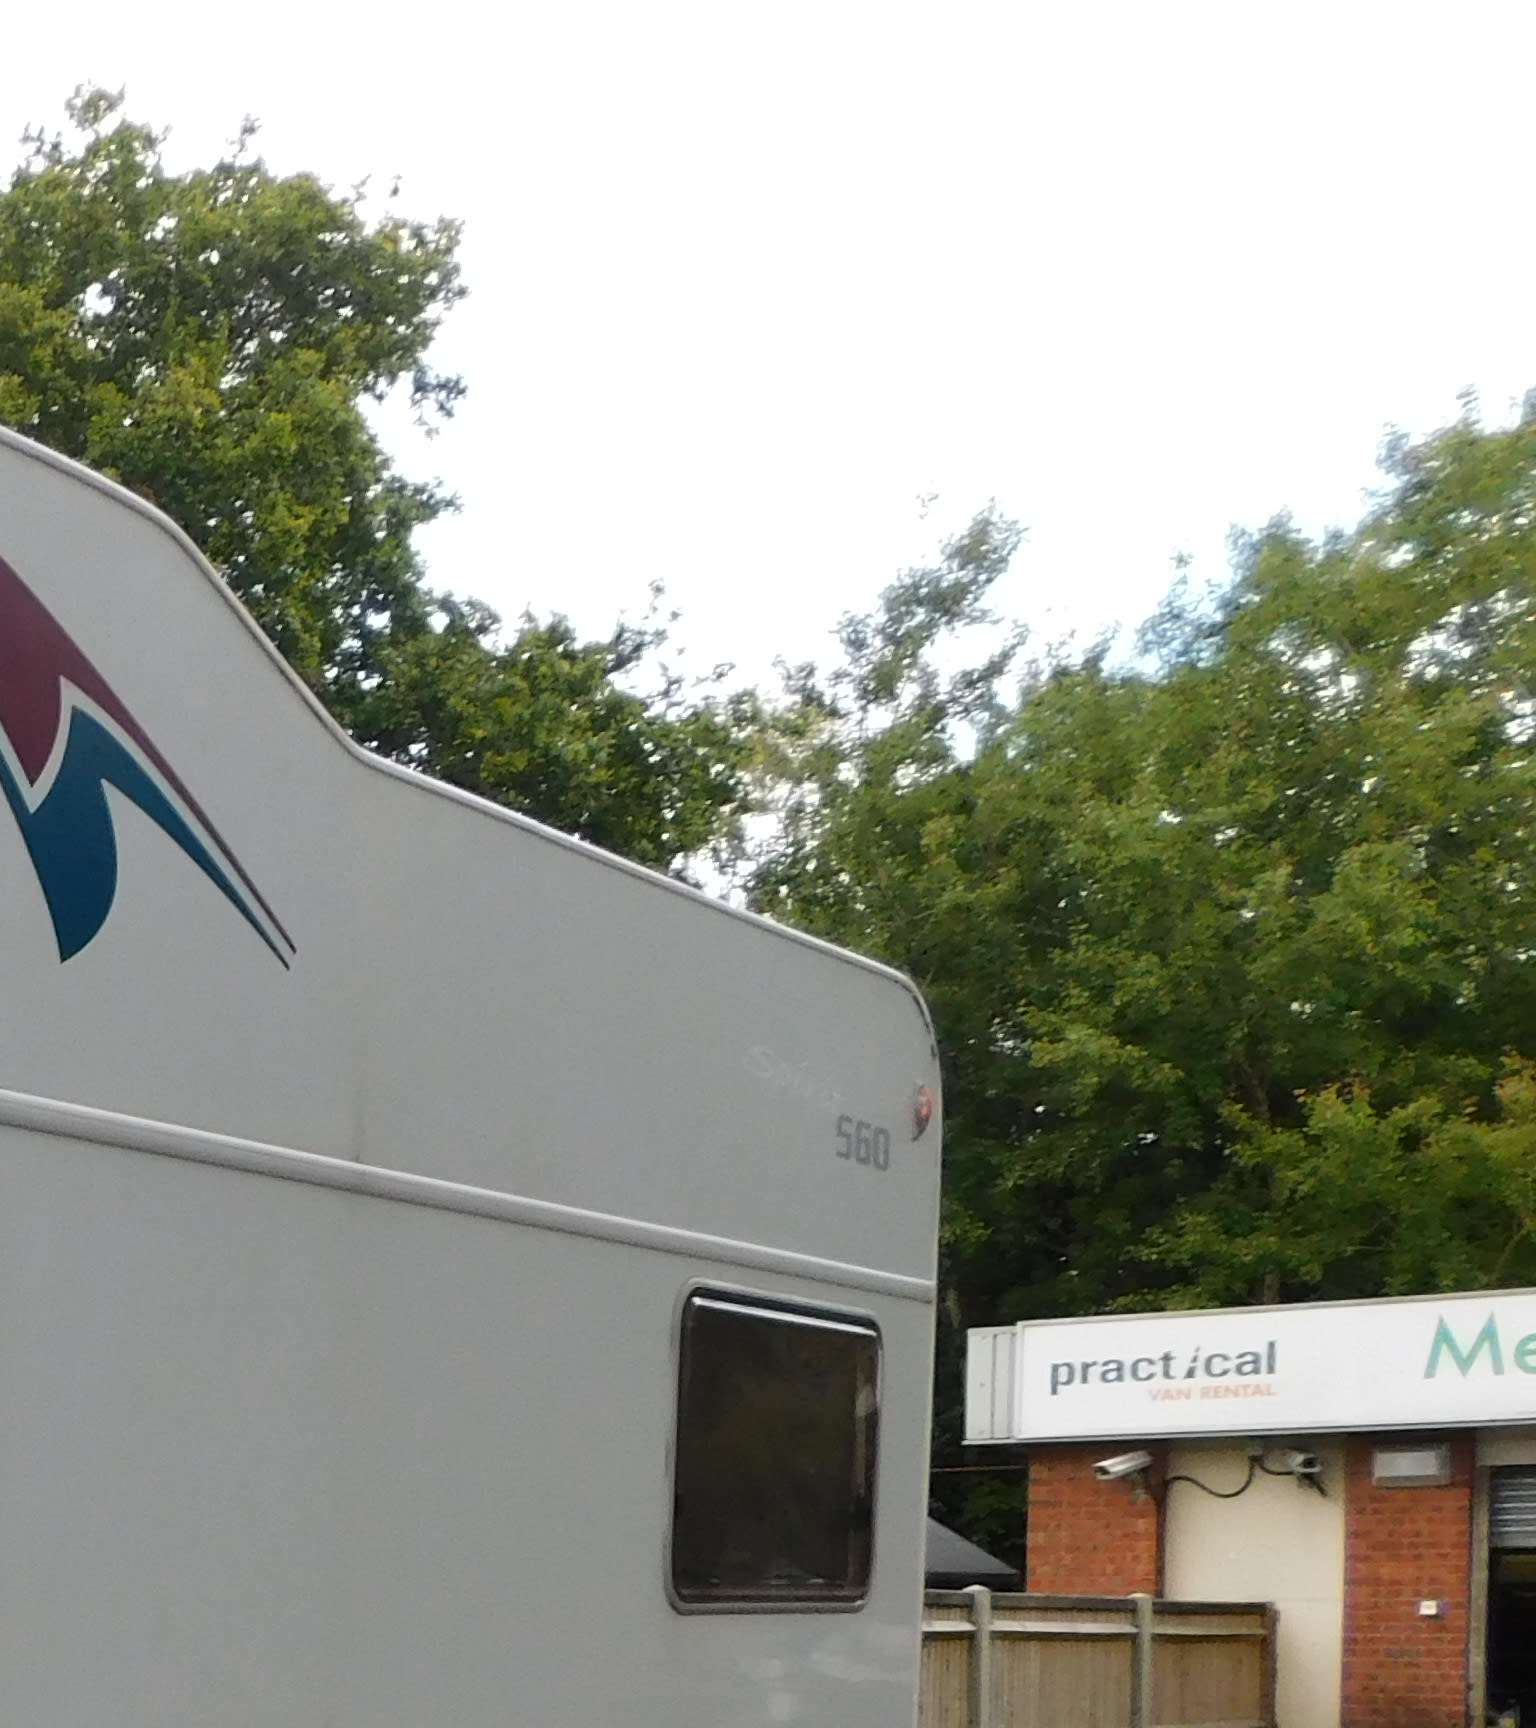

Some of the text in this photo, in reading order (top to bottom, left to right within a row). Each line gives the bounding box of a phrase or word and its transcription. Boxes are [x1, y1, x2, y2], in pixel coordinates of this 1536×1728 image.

[835, 1114, 891, 1172] 560
[1049, 1338, 1277, 1396] practical
[1148, 1383, 1276, 1401] VAN RENTAL
